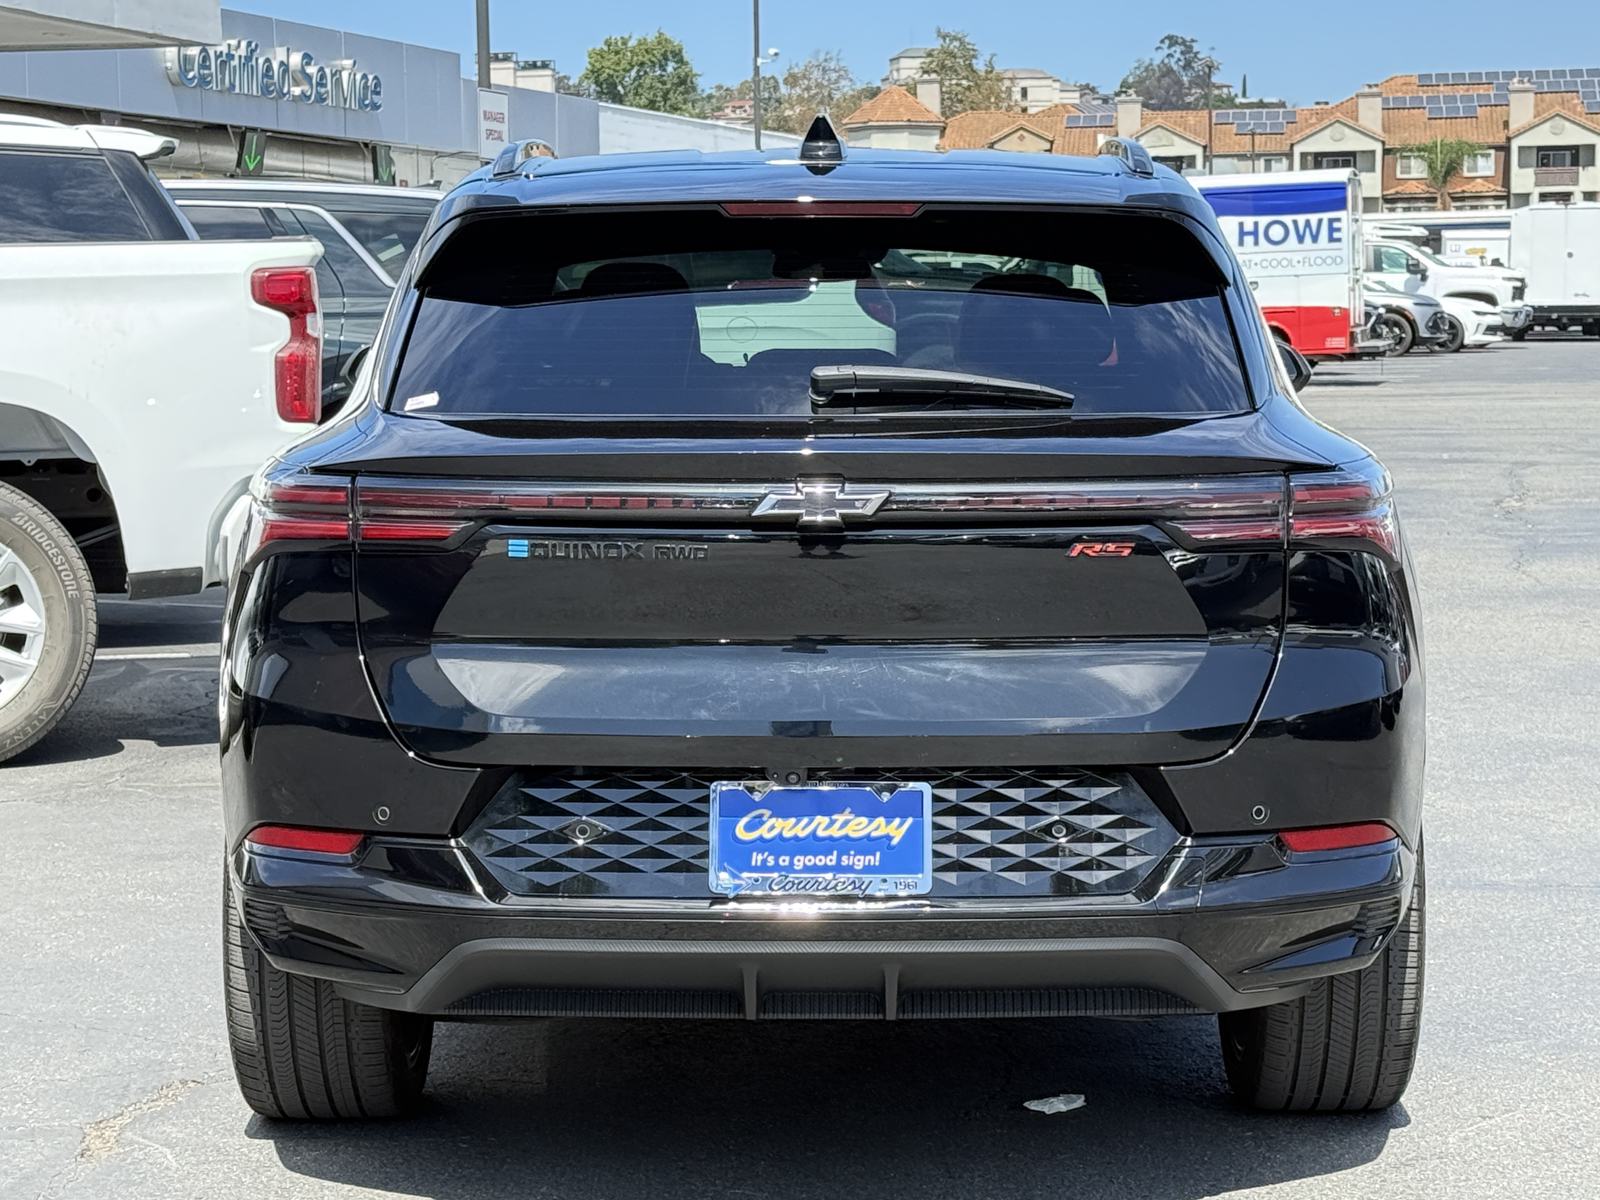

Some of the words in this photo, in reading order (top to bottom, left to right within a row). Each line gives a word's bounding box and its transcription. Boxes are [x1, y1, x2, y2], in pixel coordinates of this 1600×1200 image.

[172, 39, 291, 101] Certified
[298, 51, 383, 112] Service
[485, 128, 504, 142] SPECIAL
[1237, 217, 1343, 248] HOWE
[1259, 257, 1296, 269] COOL
[1302, 255, 1344, 267] FLOOD
[11, 511, 80, 599] BRIDGESTONE
[1064, 542, 1136, 557] RS
[734, 807, 914, 846] Courtesy
[751, 851, 775, 868] It's
[778, 854, 790, 868] a
[793, 850, 838, 870] good
[840, 851, 881, 870] sign!
[767, 874, 873, 897] Courtesy
